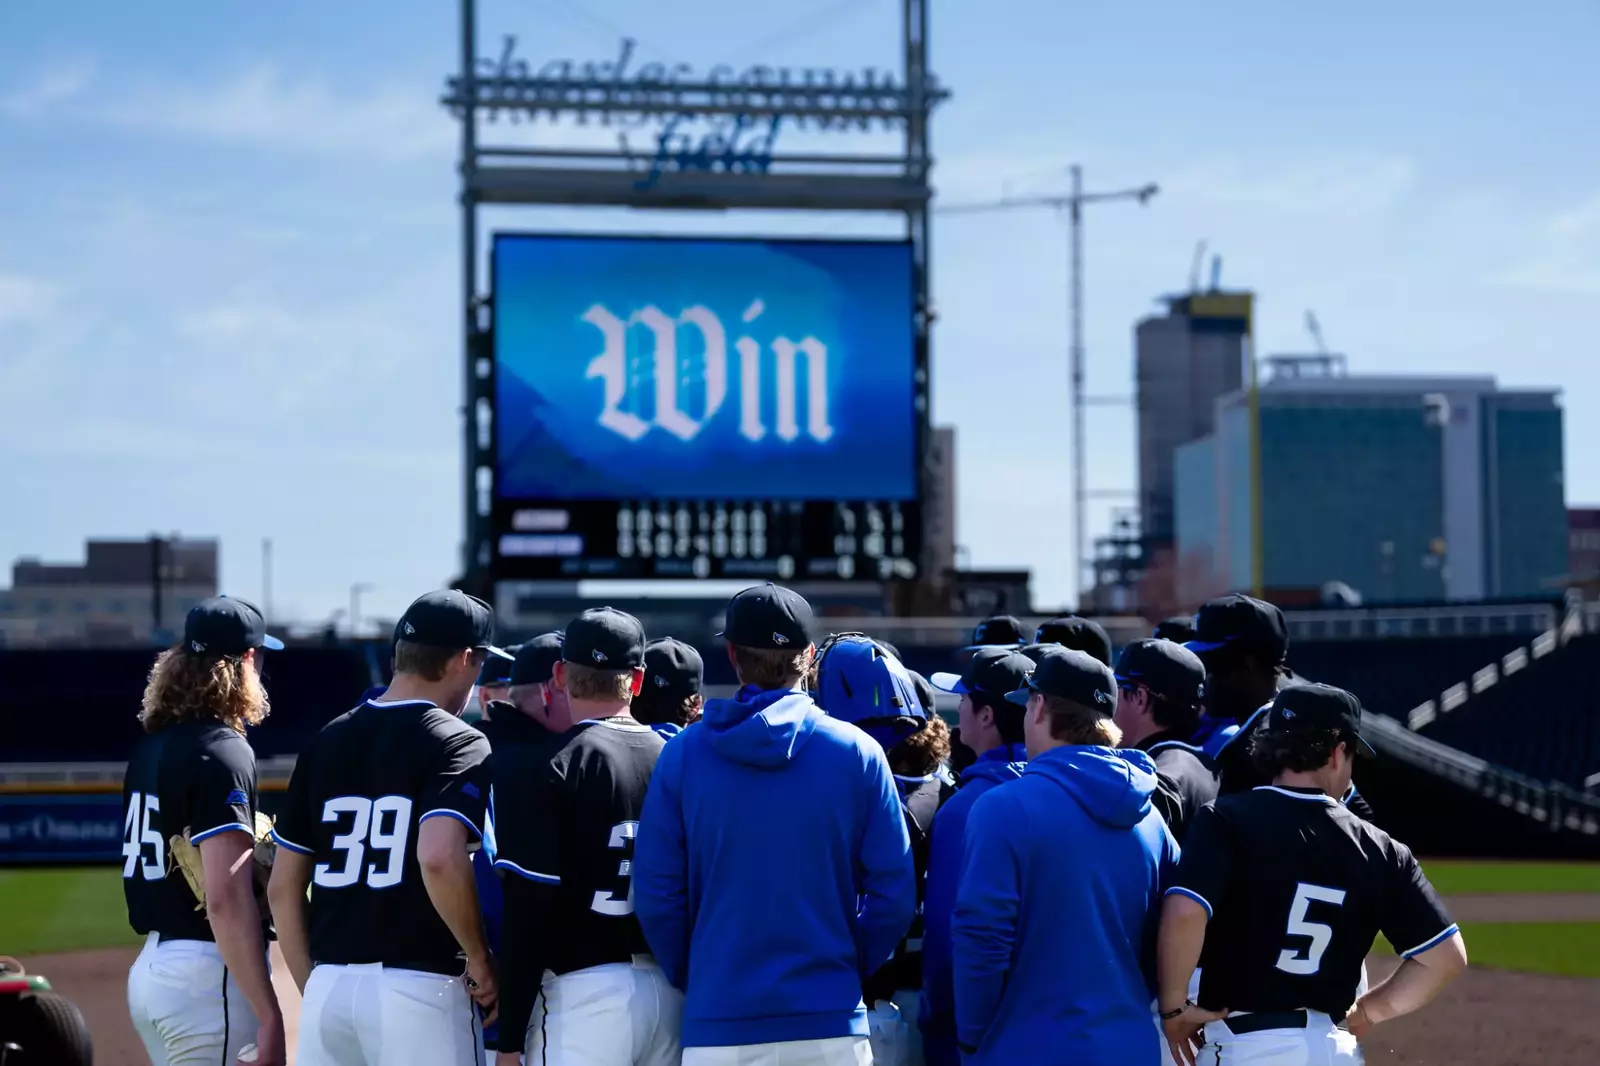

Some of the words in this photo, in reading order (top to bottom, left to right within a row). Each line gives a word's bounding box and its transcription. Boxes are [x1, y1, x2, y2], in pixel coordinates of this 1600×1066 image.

[580, 298, 833, 442] Win
[122, 792, 165, 880] 45
[314, 795, 413, 888] 39
[1275, 882, 1346, 976] 5
